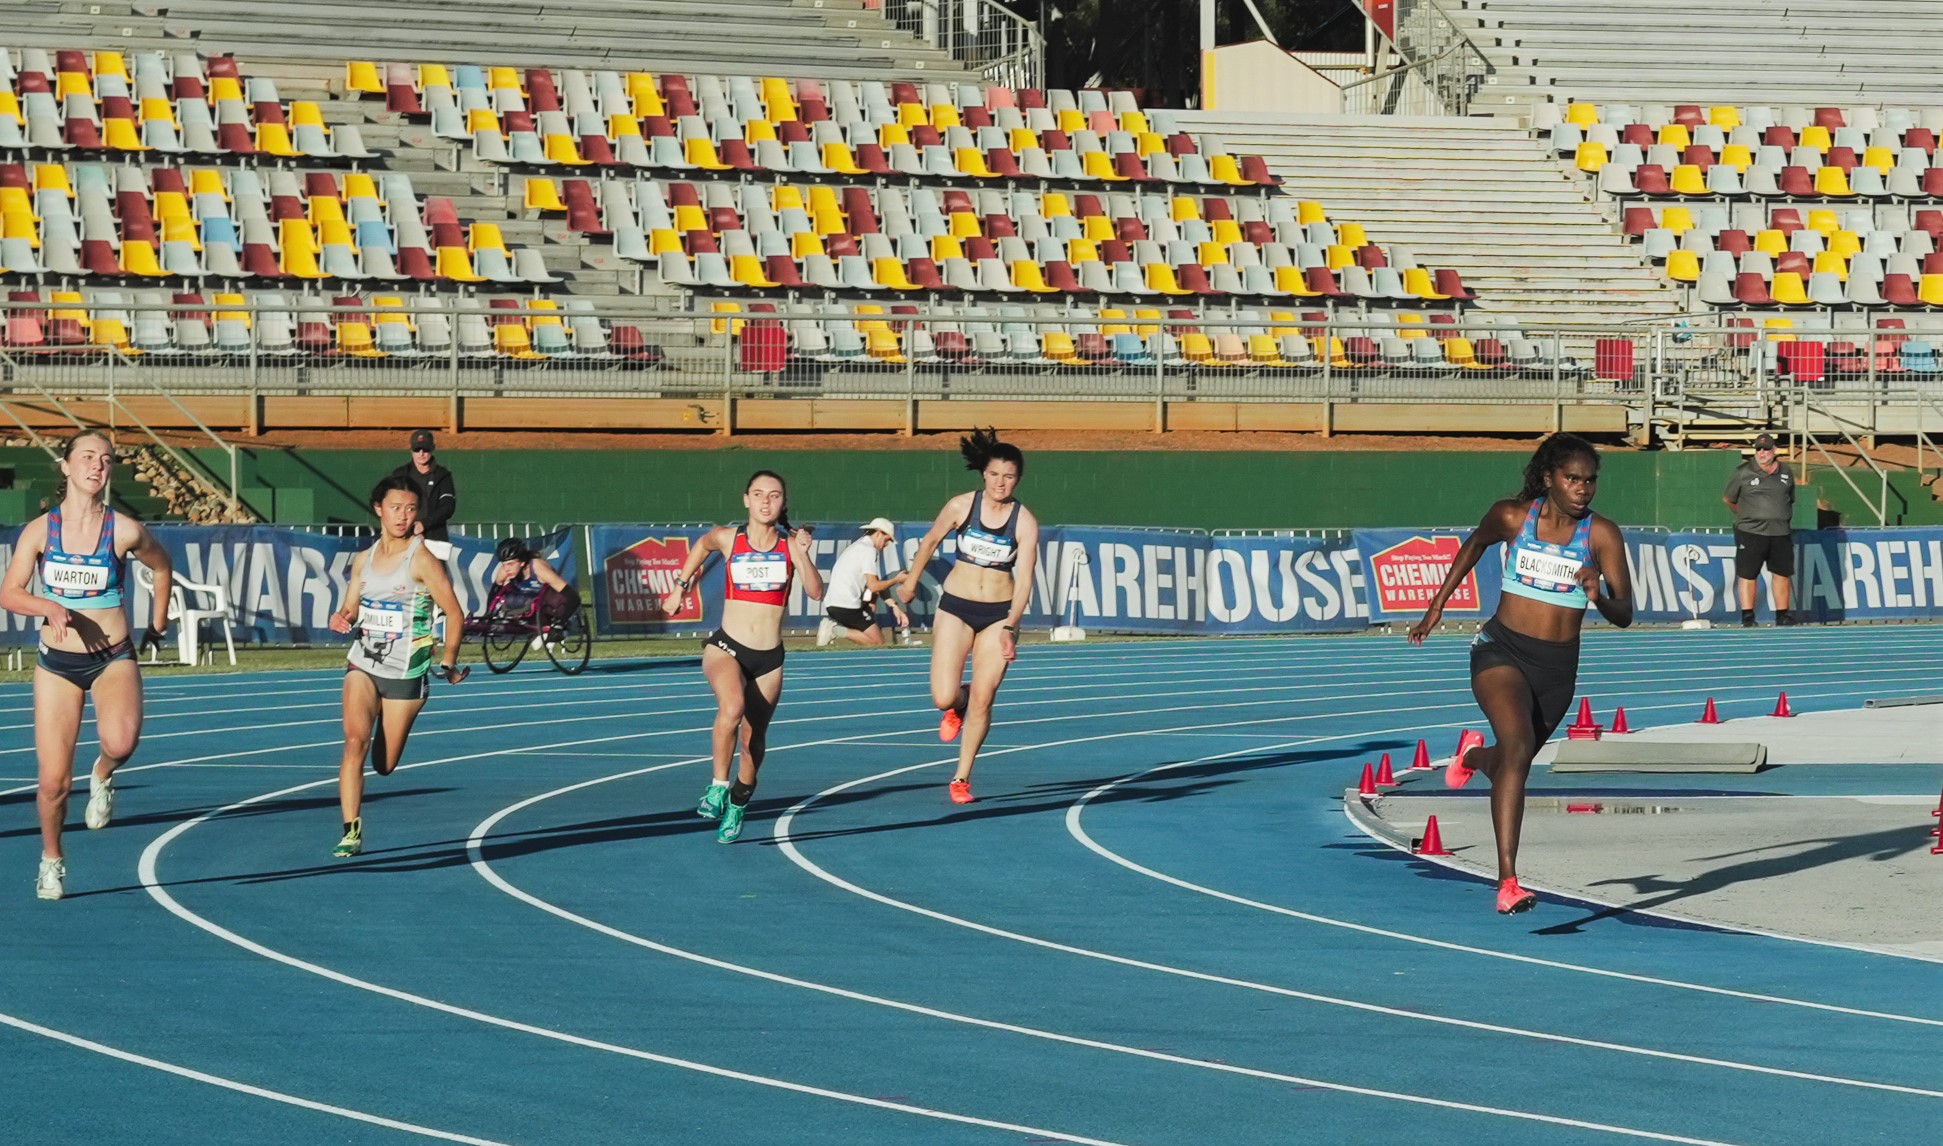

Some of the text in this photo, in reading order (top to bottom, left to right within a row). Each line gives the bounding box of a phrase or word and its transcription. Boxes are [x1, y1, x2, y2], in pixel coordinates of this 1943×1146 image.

[971, 543, 1002, 558] WRIGHT
[747, 566, 769, 579] POST
[1380, 563, 1468, 587] CHEMI
[1519, 556, 1575, 579] BLACKSMITH
[54, 569, 98, 585] WARTON
[612, 568, 697, 595] CHEMI
[1385, 588, 1471, 602] WAREHSE
